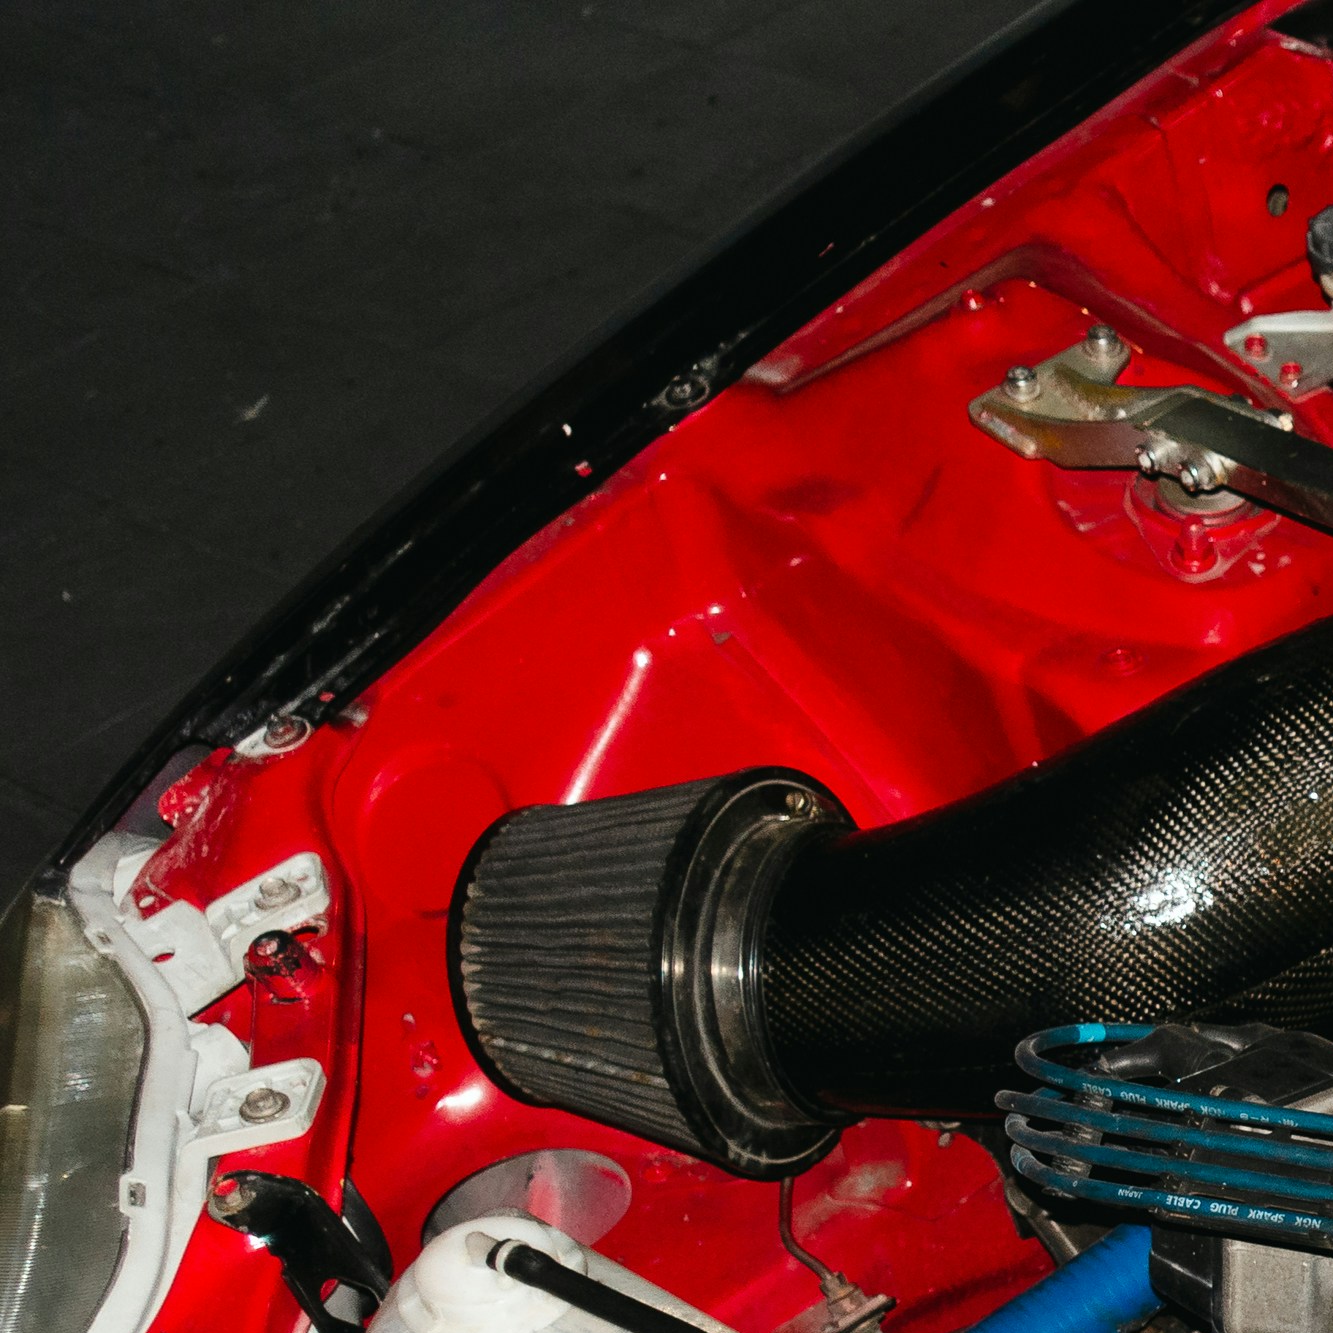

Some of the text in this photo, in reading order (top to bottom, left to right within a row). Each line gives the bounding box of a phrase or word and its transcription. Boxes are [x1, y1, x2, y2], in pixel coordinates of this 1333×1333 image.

[1119, 1091, 1147, 1105] PLUG
[1155, 1097, 1191, 1111] SPARK
[1118, 1188, 1144, 1200] JAPAN
[1166, 1194, 1202, 1210] CABLE
[1210, 1202, 1240, 1217] PLUG
[1247, 1208, 1286, 1224] SPARK
[1295, 1216, 1322, 1230] NGK
